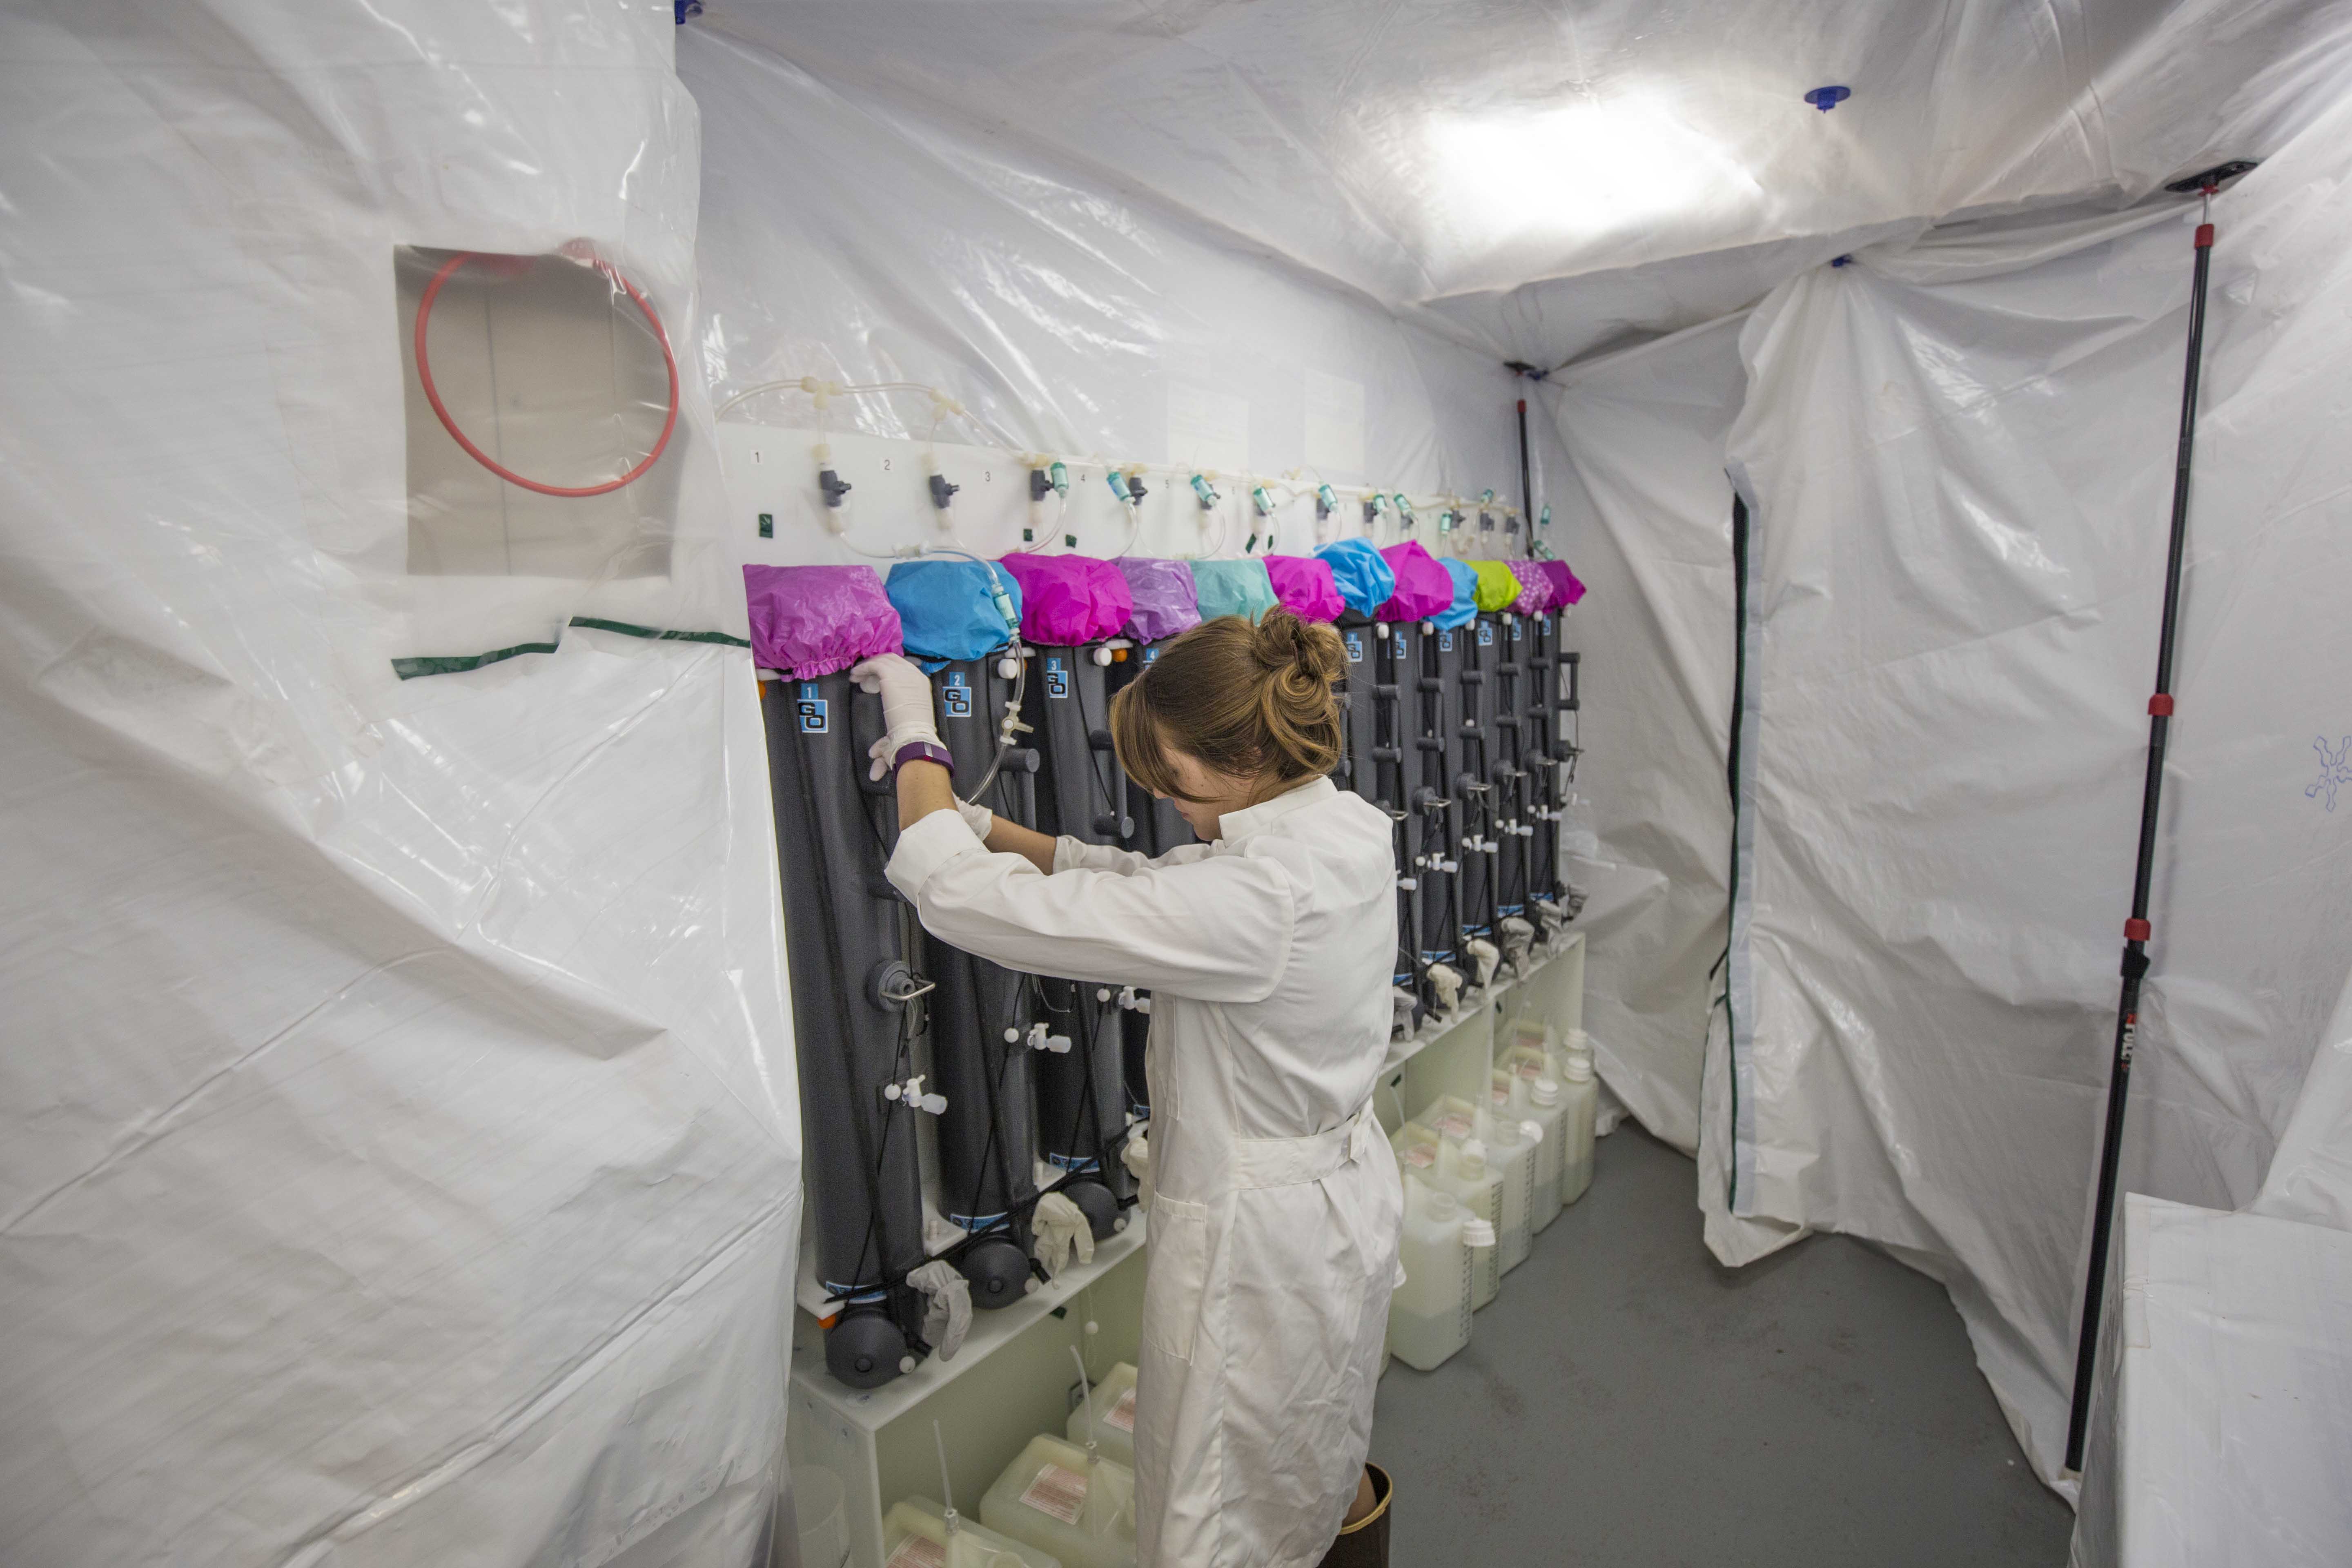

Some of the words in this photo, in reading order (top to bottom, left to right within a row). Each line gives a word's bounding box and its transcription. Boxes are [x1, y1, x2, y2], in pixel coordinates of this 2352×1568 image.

[755, 451, 759, 463] 1
[884, 459, 890, 470] 2
[985, 471, 990, 482] 3
[1080, 473, 1085, 483] 4
[1165, 479, 1170, 489] 5
[1149, 650, 1155, 660] 4
[1051, 660, 1057, 670] 3
[954, 675, 960, 686] 2
[1047, 673, 1065, 695] GO
[806, 686, 812, 699] 1
[944, 688, 969, 713] GO
[798, 702, 825, 729] GO
